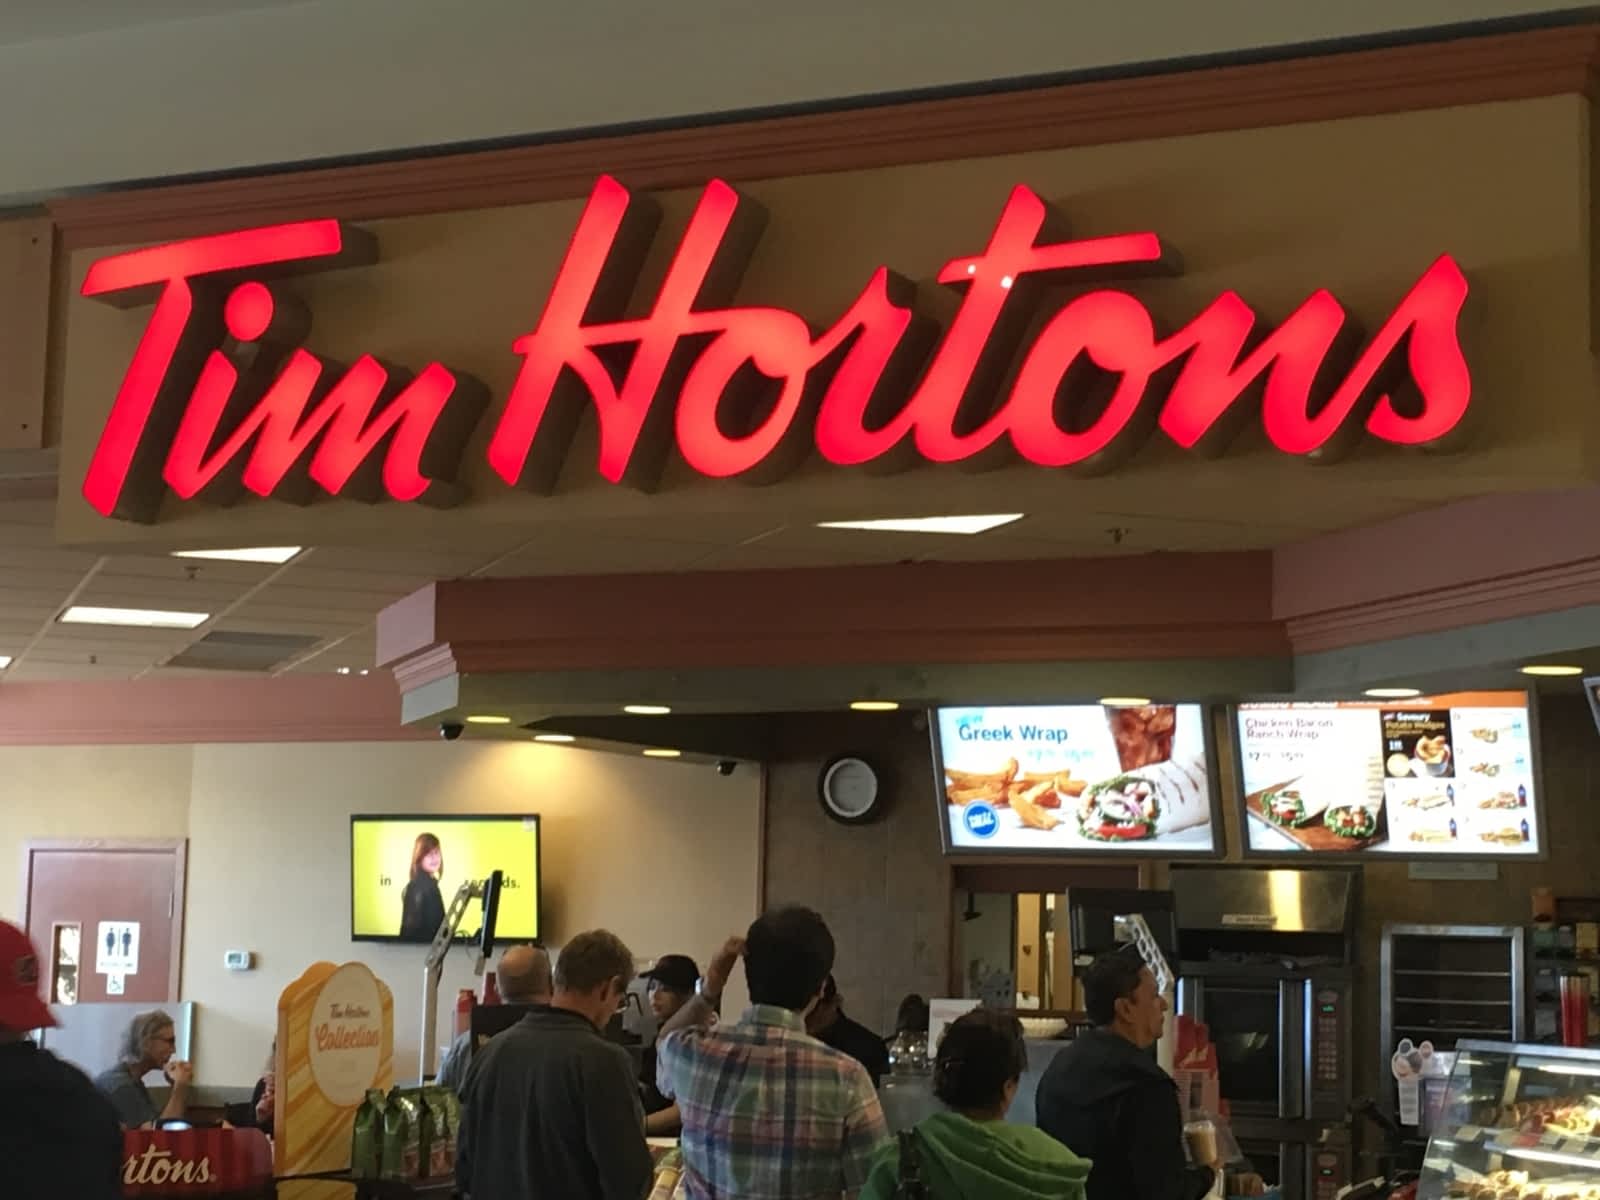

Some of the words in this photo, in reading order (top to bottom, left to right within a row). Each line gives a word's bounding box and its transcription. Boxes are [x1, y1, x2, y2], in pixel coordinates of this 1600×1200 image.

[82, 219, 456, 518] Tim
[488, 175, 1471, 484] Hortons
[958, 723, 1014, 742] Greek
[1018, 723, 1069, 745] Wrap
[380, 875, 392, 886] in
[314, 1023, 380, 1052] Collection
